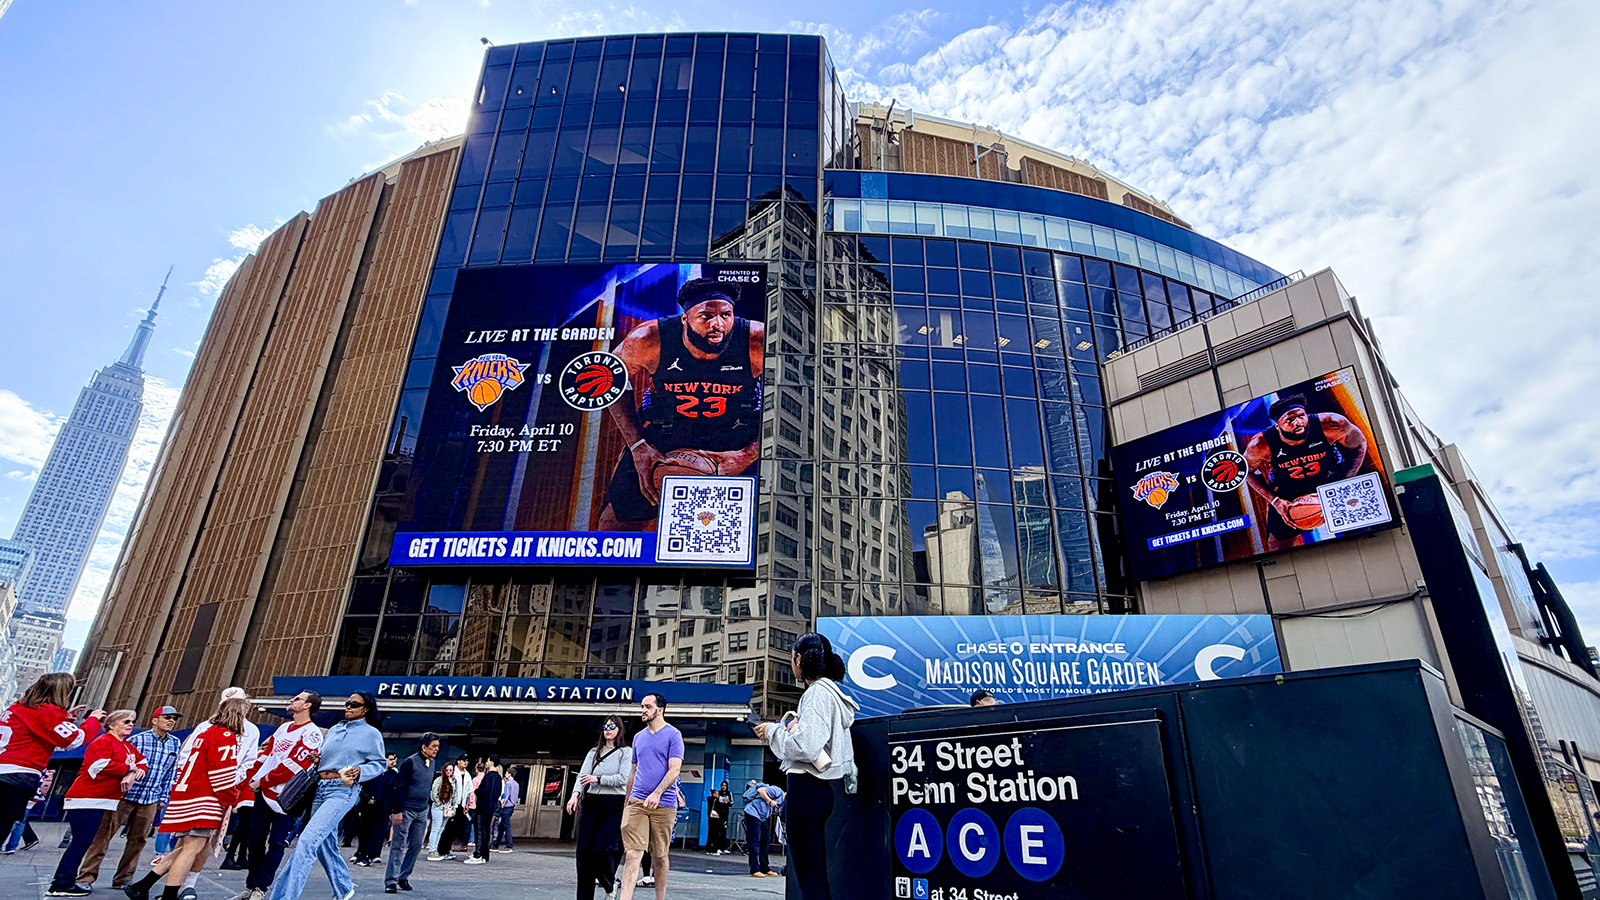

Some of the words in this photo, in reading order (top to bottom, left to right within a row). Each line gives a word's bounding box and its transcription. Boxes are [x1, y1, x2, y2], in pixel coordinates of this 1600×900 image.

[717, 275, 750, 283] CHASE
[464, 329, 509, 344] LIVE
[511, 328, 530, 342] AT
[533, 328, 558, 341] THE
[561, 327, 615, 341] GARDEN
[454, 359, 524, 386] KNICKS
[567, 354, 623, 376] TORONTO
[664, 382, 700, 393] NEW
[700, 382, 744, 395] YORK
[1315, 379, 1344, 392] CHASE
[564, 385, 622, 408] RAPTORS
[676, 395, 728, 418] 23
[469, 424, 515, 439] Friday,
[518, 423, 554, 438] April
[558, 423, 575, 436] 10
[476, 440, 504, 453] 7:30
[507, 439, 535, 452] PM
[537, 439, 562, 452] ET
[1135, 455, 1162, 473] LIVE
[1163, 451, 1176, 463] AT
[1176, 445, 1195, 458] THE
[1195, 433, 1233, 453] GARDEN
[1205, 453, 1243, 473] TORONTO
[1278, 458, 1300, 469] NEW
[1300, 451, 1327, 465] YORK
[1287, 461, 1321, 479] 23
[1135, 472, 1178, 497] KNICKS
[1207, 470, 1246, 490] RAPTORS
[1191, 502, 1210, 513] April
[1211, 499, 1221, 508] 10
[1172, 517, 1187, 526] 7:30
[1188, 514, 1202, 523] PM
[1203, 510, 1216, 519] ET
[1151, 537, 1164, 547] GET
[1165, 531, 1191, 545] TICKETS
[1191, 528, 1200, 538] AT
[1200, 517, 1245, 536] KNICKS.COM
[408, 537, 440, 558] GET
[443, 537, 508, 558] TICKETS
[510, 537, 534, 558] AT
[536, 537, 643, 558] KNICKS.COM
[956, 642, 1008, 654] CHASE
[1029, 642, 1126, 654] ENTRANCE
[847, 644, 898, 691] C
[925, 658, 1007, 685] MADISON
[1012, 657, 1083, 685] SQUARE
[1194, 644, 1246, 681] C
[377, 682, 538, 699] PENNSYLVANIA
[546, 685, 634, 700] STATION
[217, 744, 238, 762] 71
[293, 746, 310, 762] 19
[891, 744, 926, 774] 34
[935, 736, 1025, 772] Street
[892, 776, 956, 805] Penn
[966, 769, 1079, 804] Station
[906, 822, 931, 858] A
[958, 821, 987, 862] C
[1019, 824, 1048, 865] E
[930, 887, 944, 900] at
[948, 887, 968, 900] 34
